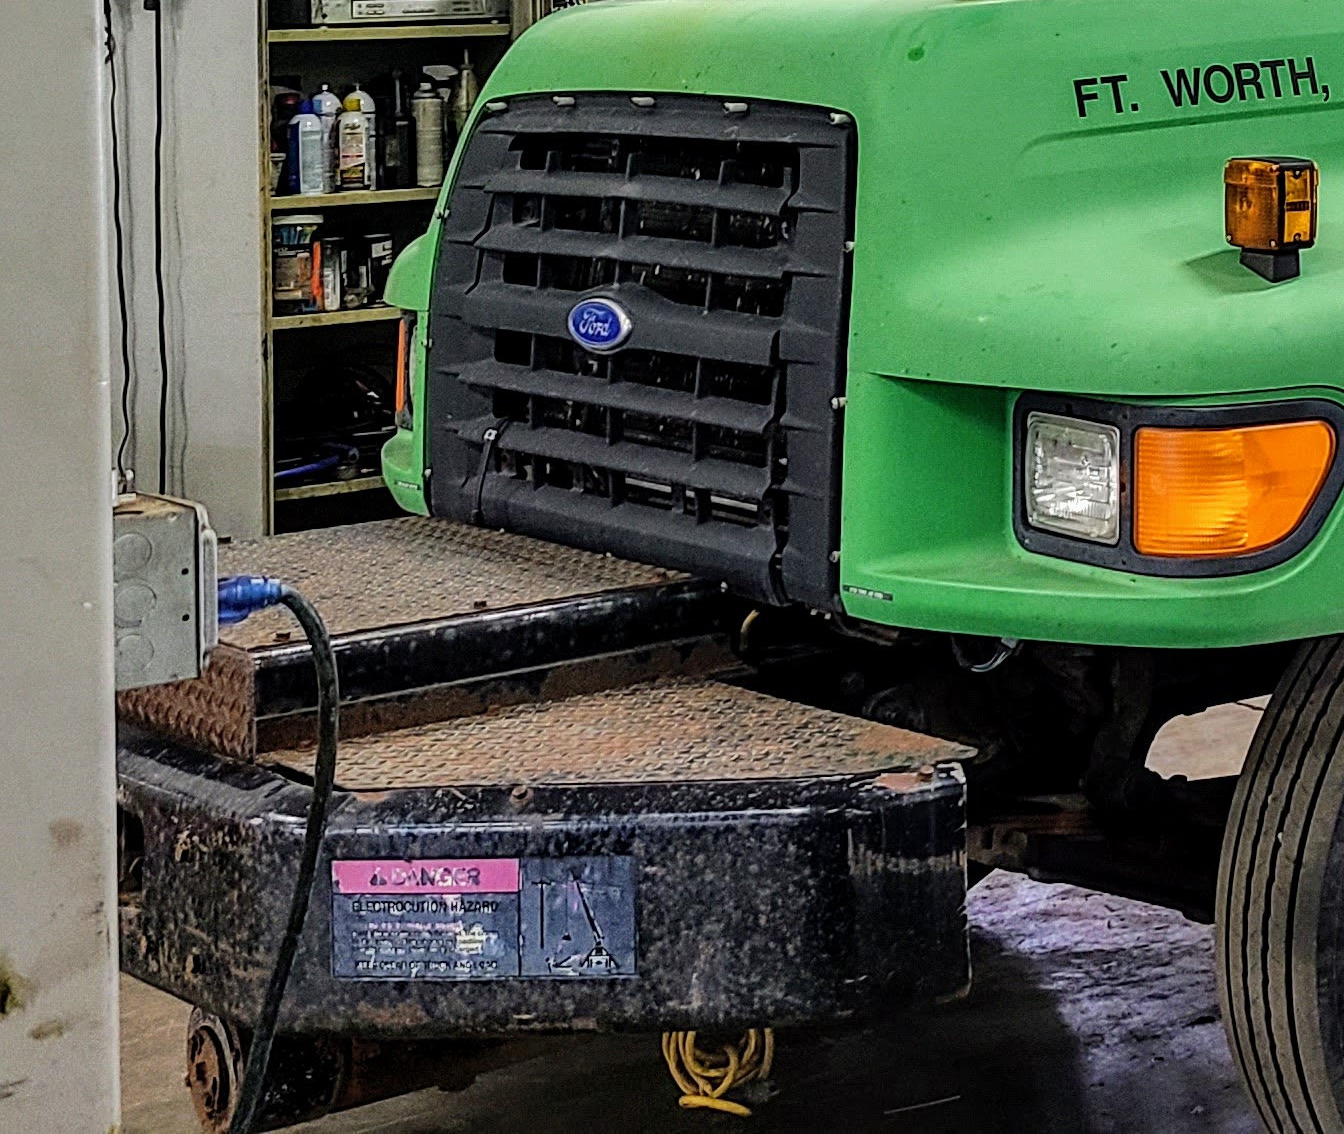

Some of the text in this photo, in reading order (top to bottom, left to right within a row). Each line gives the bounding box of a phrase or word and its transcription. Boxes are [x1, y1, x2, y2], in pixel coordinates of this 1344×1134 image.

[1073, 74, 1140, 118] FT.
[1160, 56, 1332, 108] WORTH,
[579, 307, 613, 338] Ford
[391, 866, 482, 887] DANGER
[351, 899, 499, 914] ELECTROCUTION HAZARD
